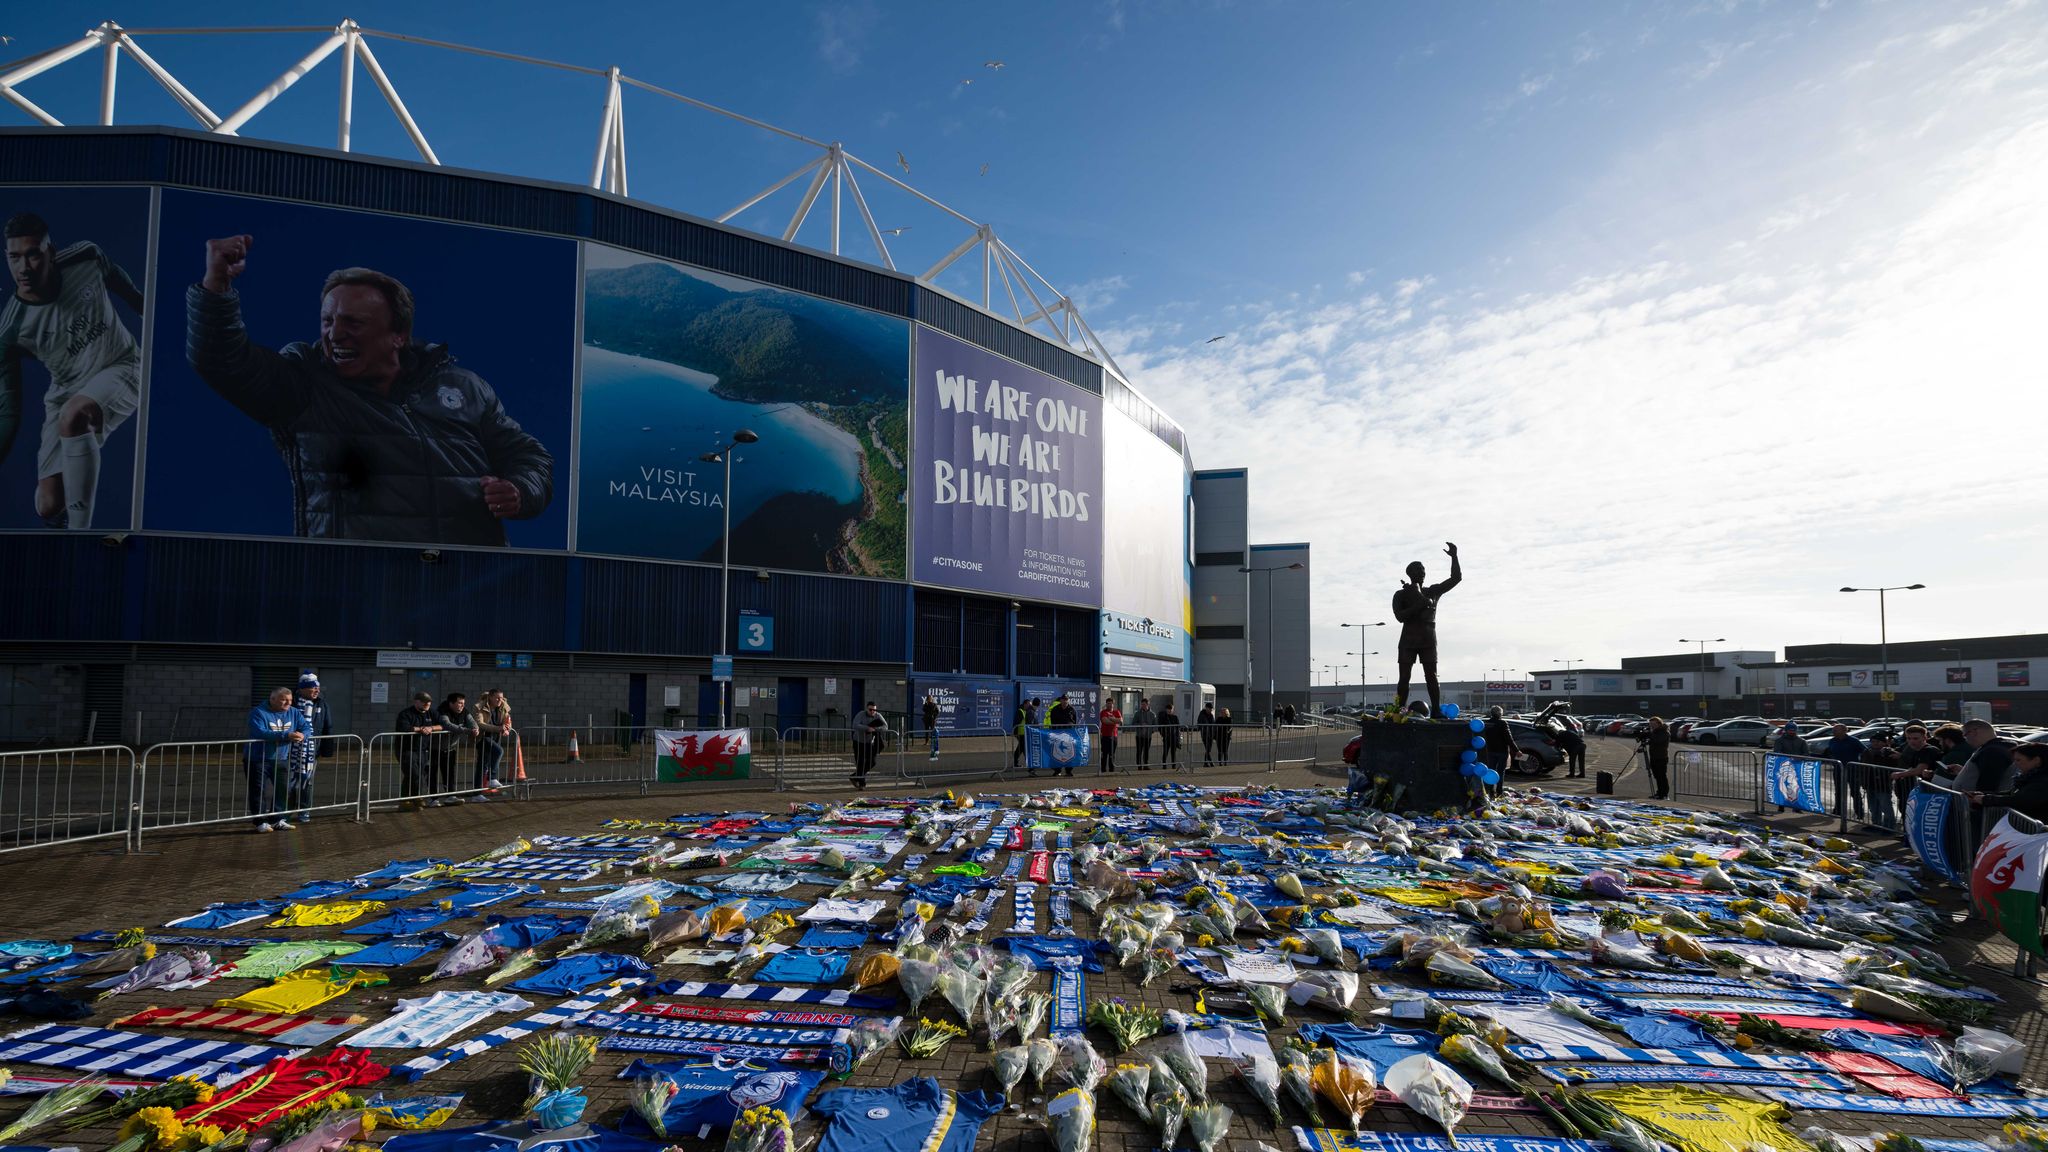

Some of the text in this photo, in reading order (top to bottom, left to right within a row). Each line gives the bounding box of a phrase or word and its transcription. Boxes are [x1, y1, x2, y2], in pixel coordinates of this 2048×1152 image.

[936, 369, 1089, 437] WE ARE ONE
[972, 425, 1061, 473] WE ARE
[640, 465, 697, 487] VISIT
[609, 480, 724, 509] MALAYSIA
[934, 459, 1090, 522] BLUEBIRDS
[932, 556, 983, 572] #CITYASONE
[1022, 560, 1087, 578] & INFORMATION VISIT
[1023, 549, 1086, 568] FOR TICKETS, NEWS
[1018, 570, 1090, 589] CARDIFFCITYFC.CO.UK
[747, 623, 765, 647] 3
[1119, 618, 1175, 639] TICKET OFFICE
[1923, 795, 1945, 839] CARDIFF
[1925, 840, 1943, 865] CITY
[671, 1006, 854, 1026] WALES FRANCE
[658, 1022, 754, 1037] CARDIFF CITY
[1513, 1142, 1561, 1152] CITY
